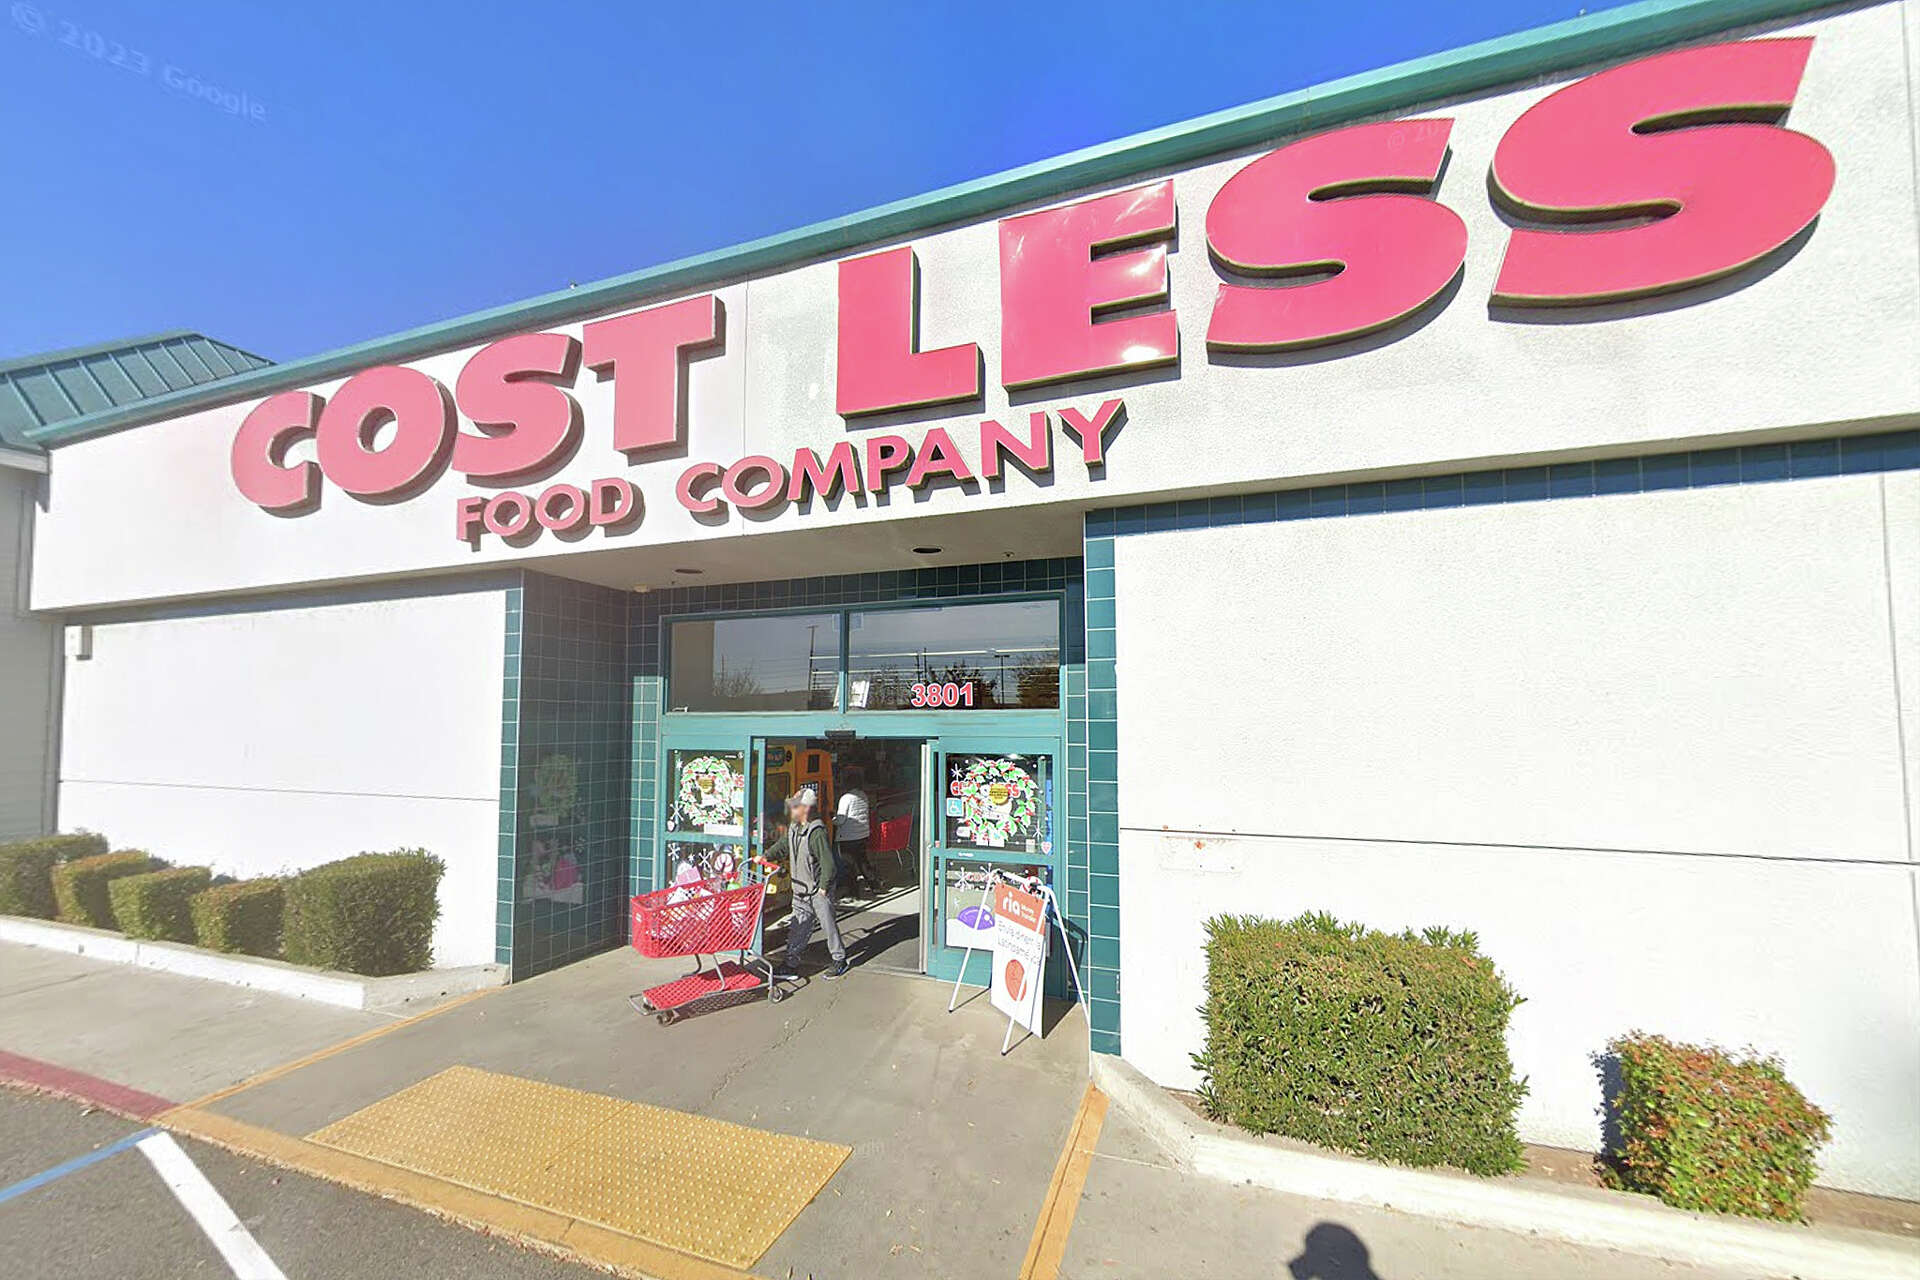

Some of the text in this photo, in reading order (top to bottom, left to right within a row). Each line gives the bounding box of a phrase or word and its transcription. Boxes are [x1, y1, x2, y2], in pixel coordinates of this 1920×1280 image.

[231, 35, 1837, 514] COST LESS
[456, 398, 1126, 546] FOOD COMPANY
[911, 682, 974, 708] 3801
[1002, 892, 1021, 916] ria
